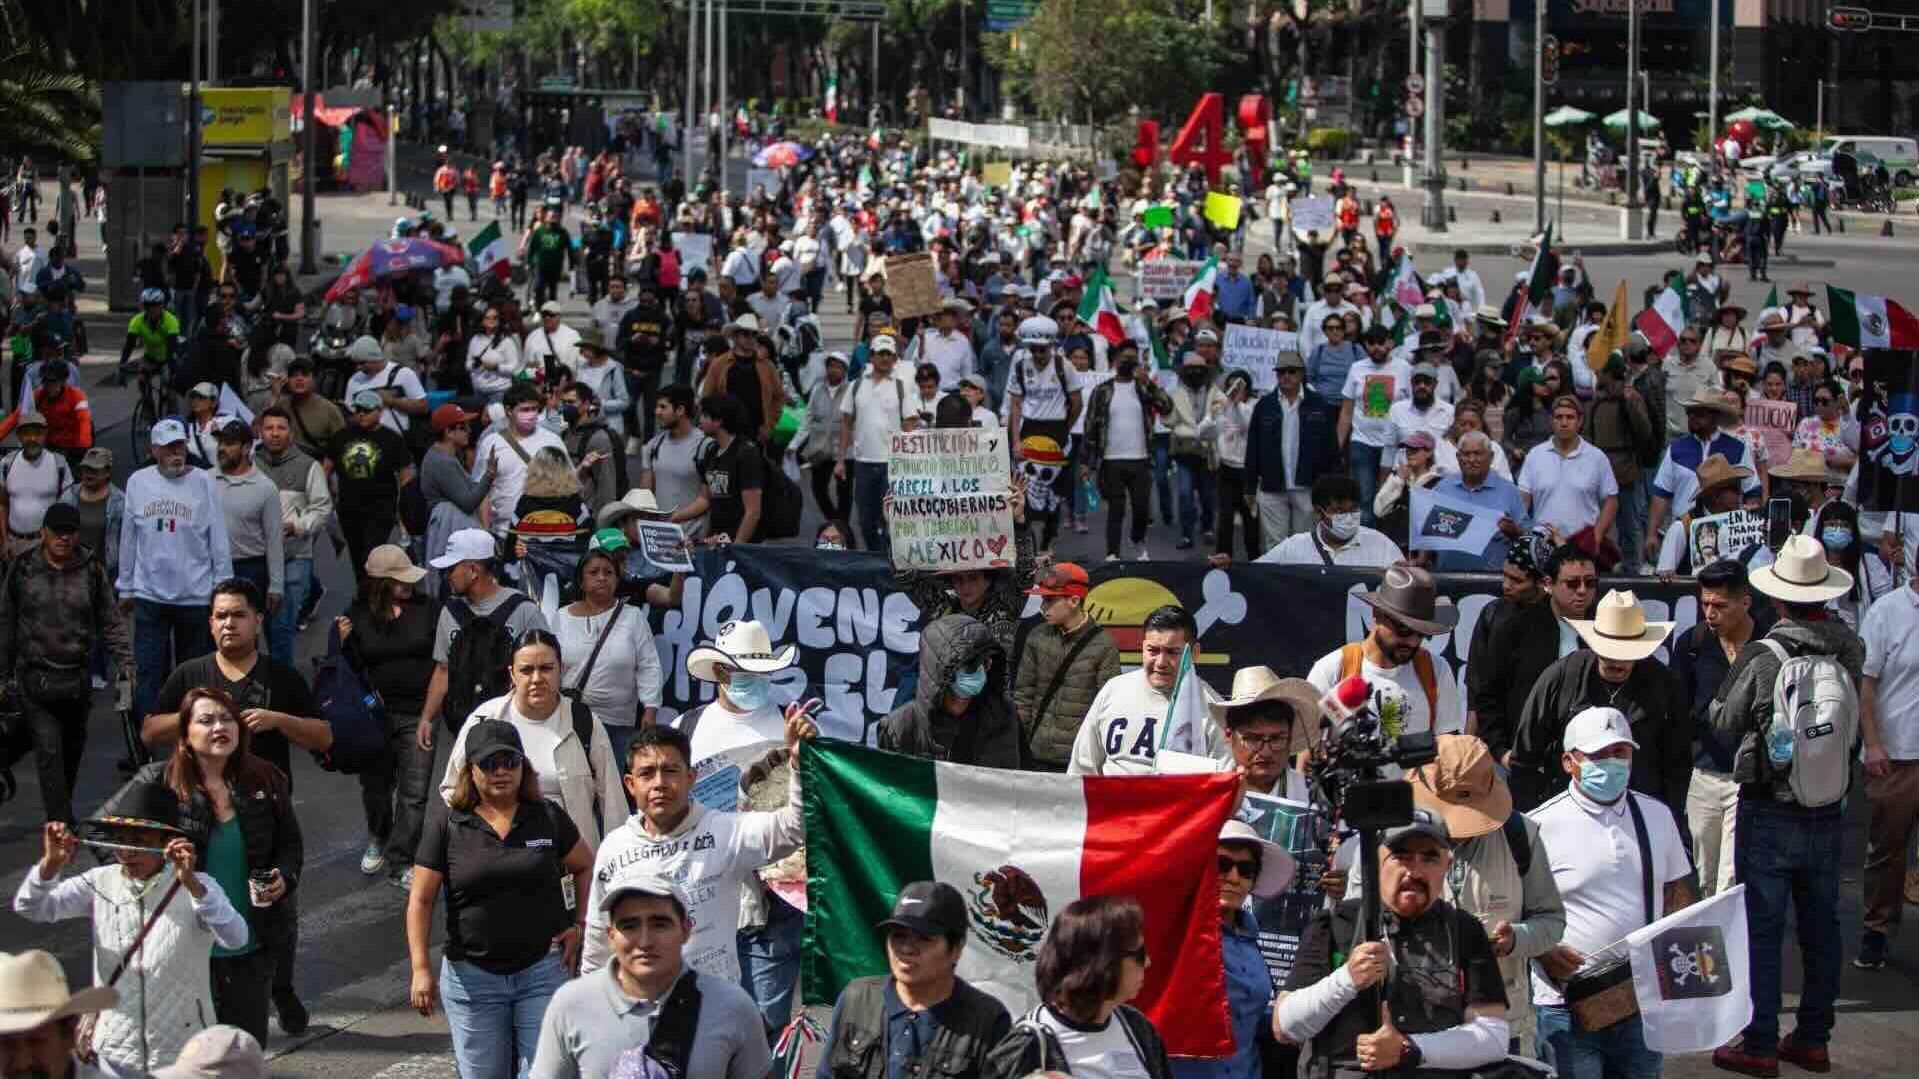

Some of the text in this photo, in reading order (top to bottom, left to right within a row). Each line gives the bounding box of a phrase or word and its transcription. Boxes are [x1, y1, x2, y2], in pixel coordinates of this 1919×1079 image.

[940, 482, 948, 494] A
[953, 478, 980, 493] LOS
[893, 494, 1007, 518] NARCOGOBIERNOS
[906, 537, 984, 563] MÉXICO
